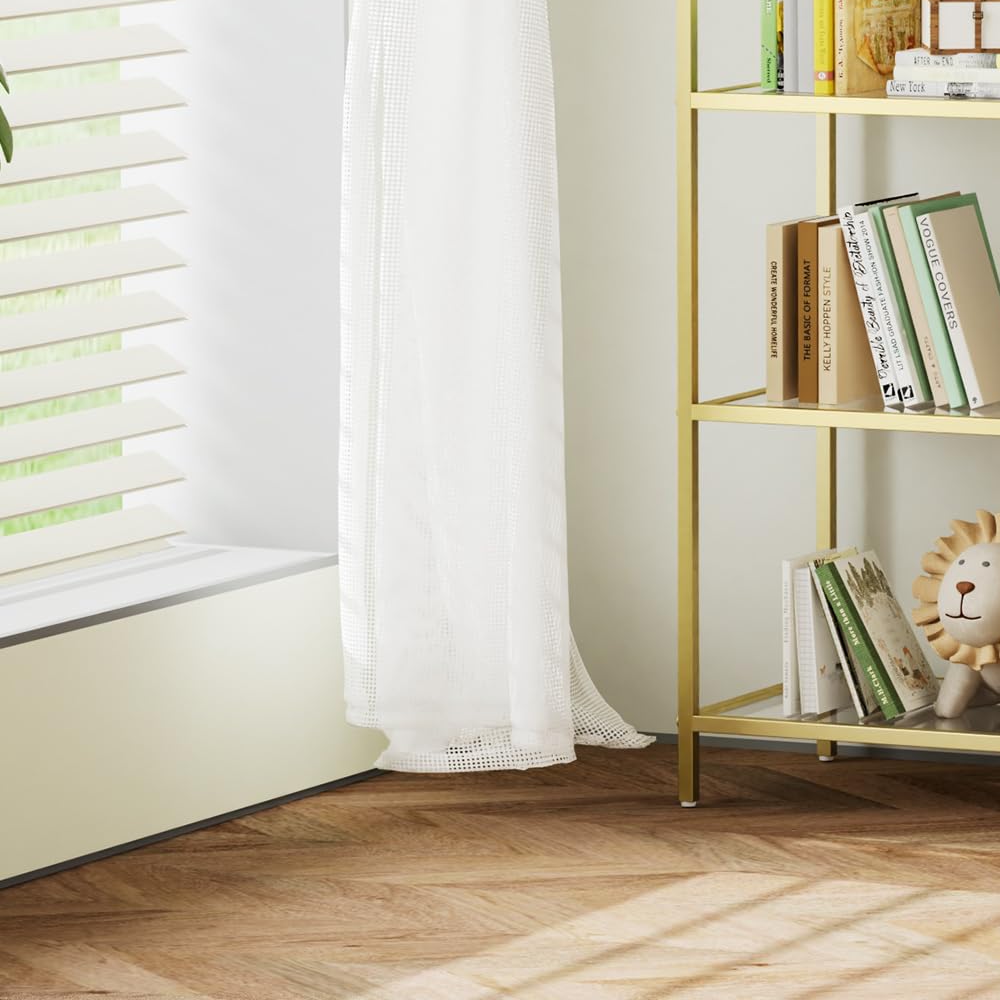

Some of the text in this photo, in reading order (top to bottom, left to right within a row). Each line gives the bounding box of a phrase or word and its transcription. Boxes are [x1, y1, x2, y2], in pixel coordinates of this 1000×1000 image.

[914, 56, 931, 65] AFTER
[942, 56, 954, 66] END
[890, 81, 926, 93] New York
[859, 219, 869, 236] 2014
[864, 238, 874, 261] SHOW
[803, 260, 811, 298] FORMAT
[920, 217, 958, 330] VOGUE COVERS
[804, 300, 811, 313] OF
[823, 266, 831, 372] KELLY HOPPEN STYLE
[880, 298, 895, 338] GRADUATE
[826, 580, 838, 601] Little
[840, 608, 850, 625] than
[848, 626, 860, 646] More
